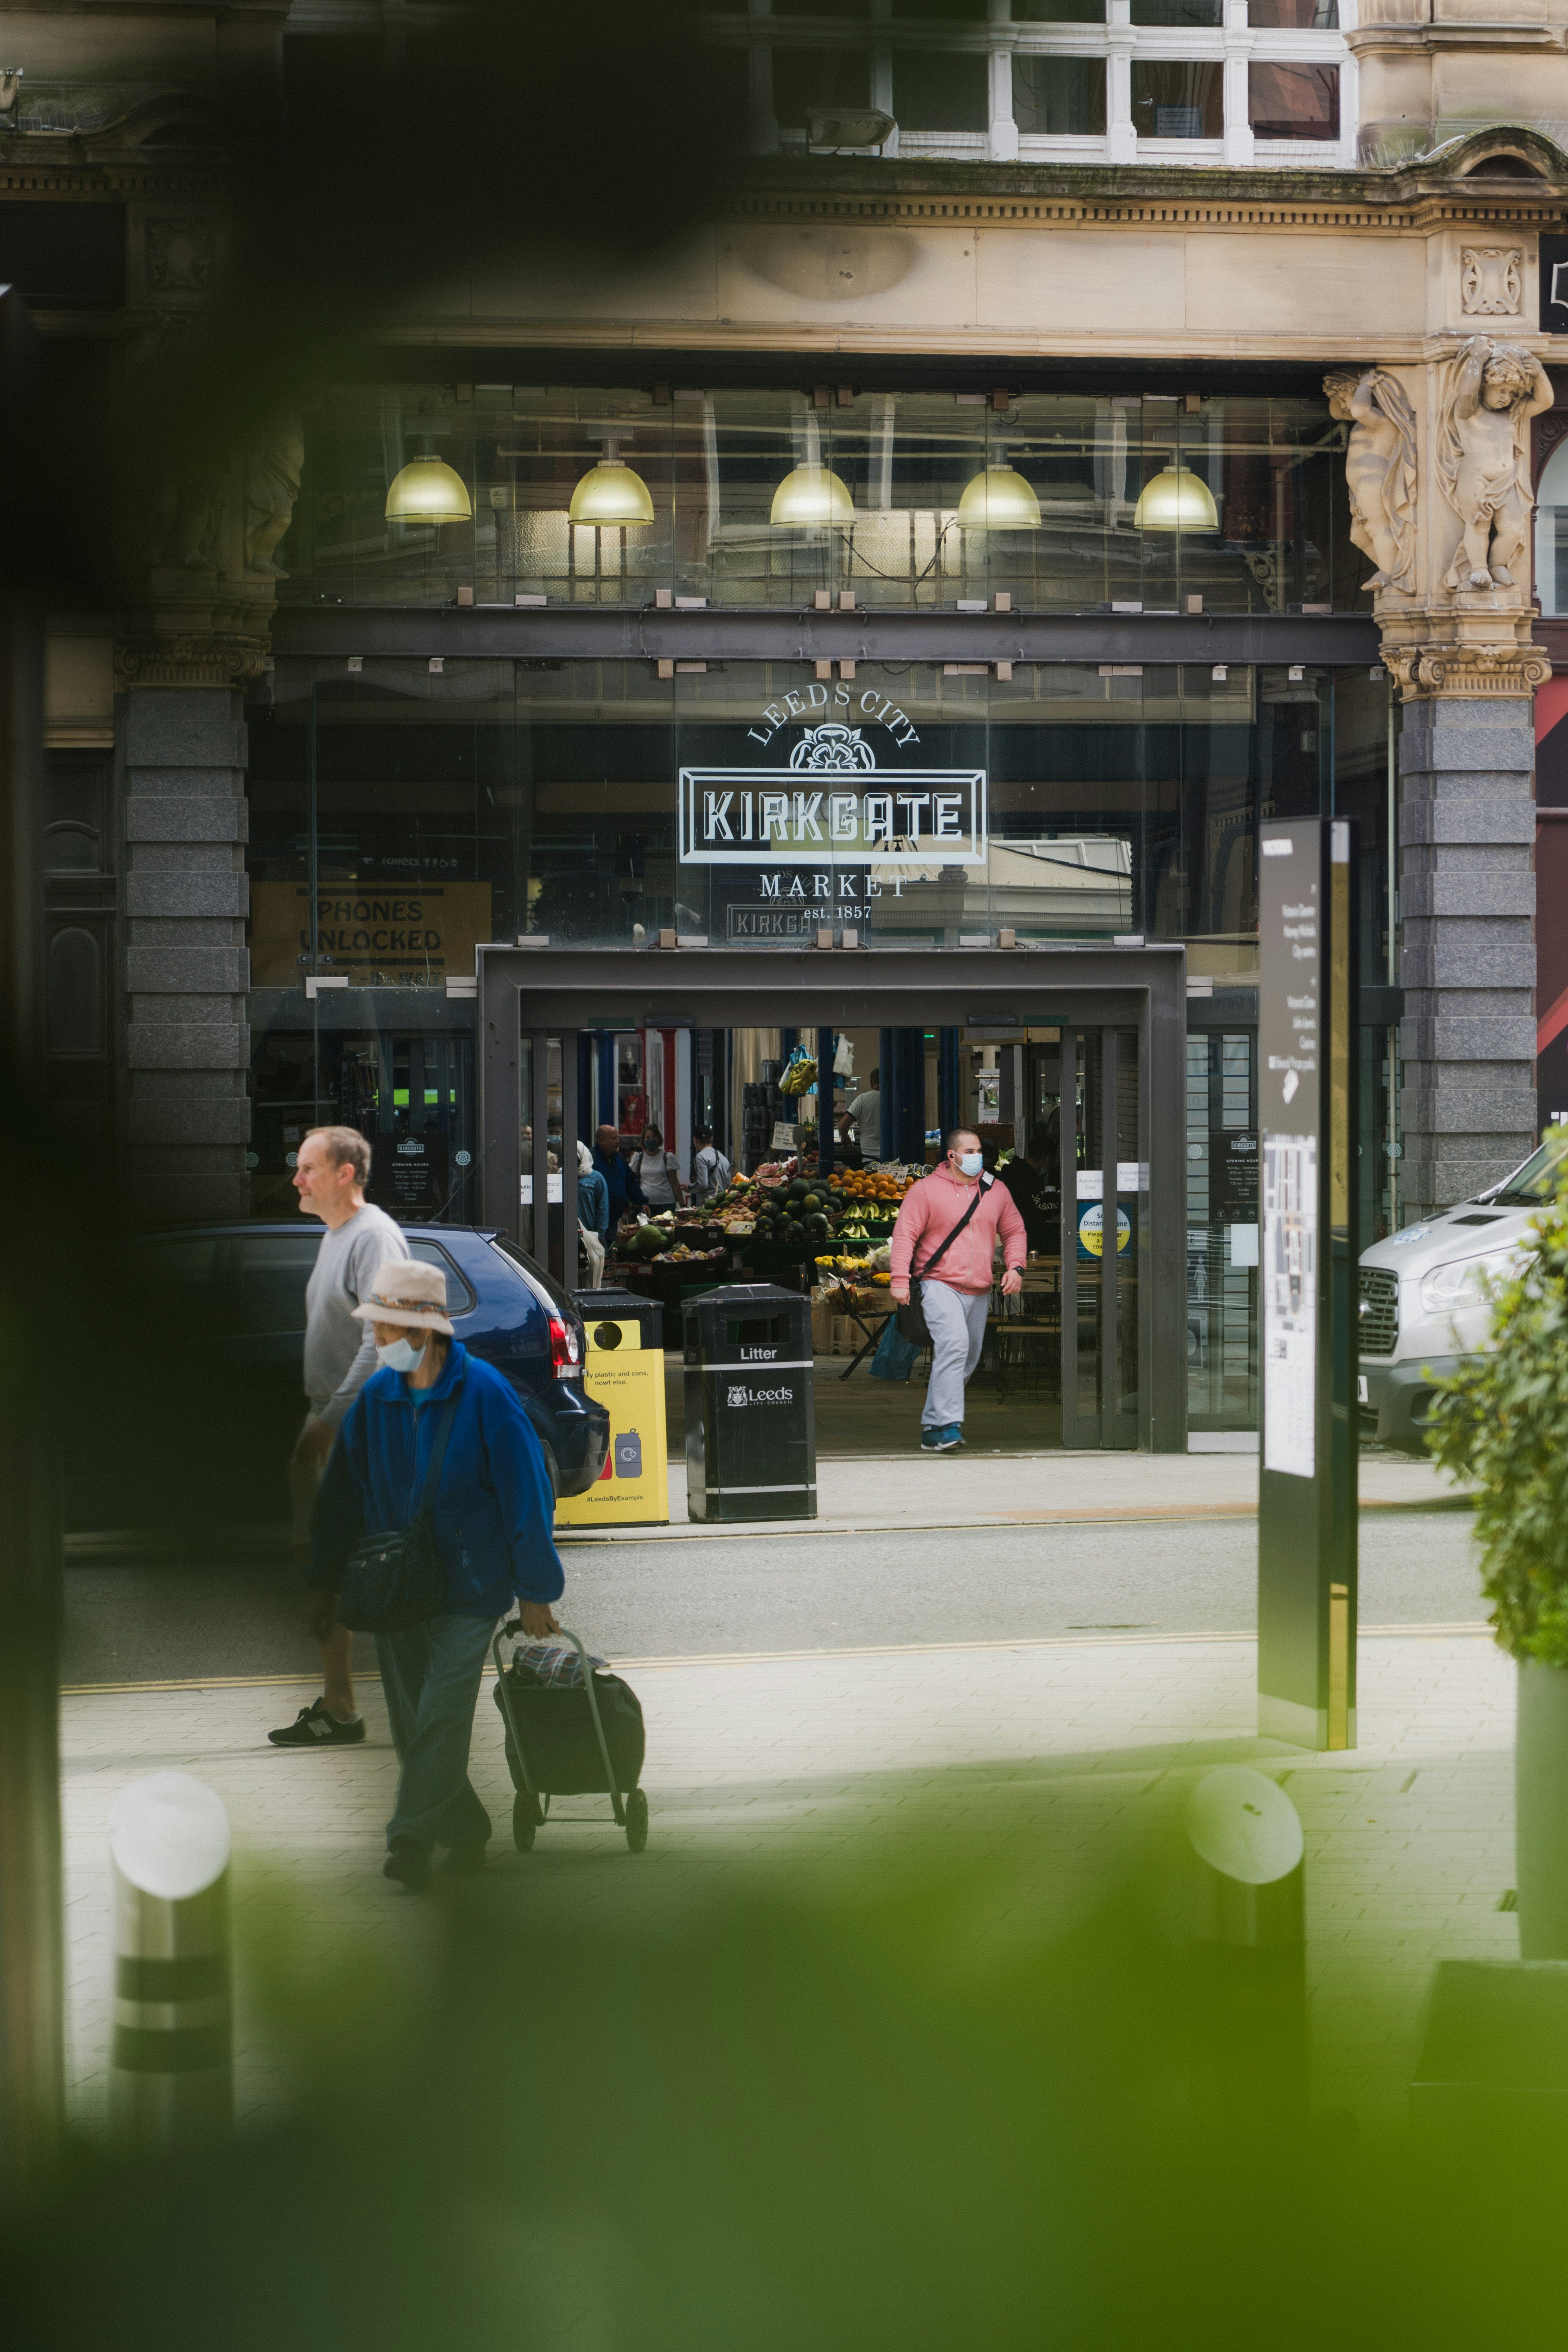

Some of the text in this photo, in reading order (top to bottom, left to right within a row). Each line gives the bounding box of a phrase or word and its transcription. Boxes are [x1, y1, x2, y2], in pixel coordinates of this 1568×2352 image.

[747, 682, 920, 748] LEEDS CITY
[702, 791, 962, 840] KIRKGATE
[759, 874, 907, 897] MARKET
[315, 900, 423, 921] PHONES
[804, 906, 871, 918] est. 1857
[299, 929, 442, 951] UNLOCKED
[740, 1348, 777, 1360] Litter
[749, 1387, 793, 1401] Leeds
